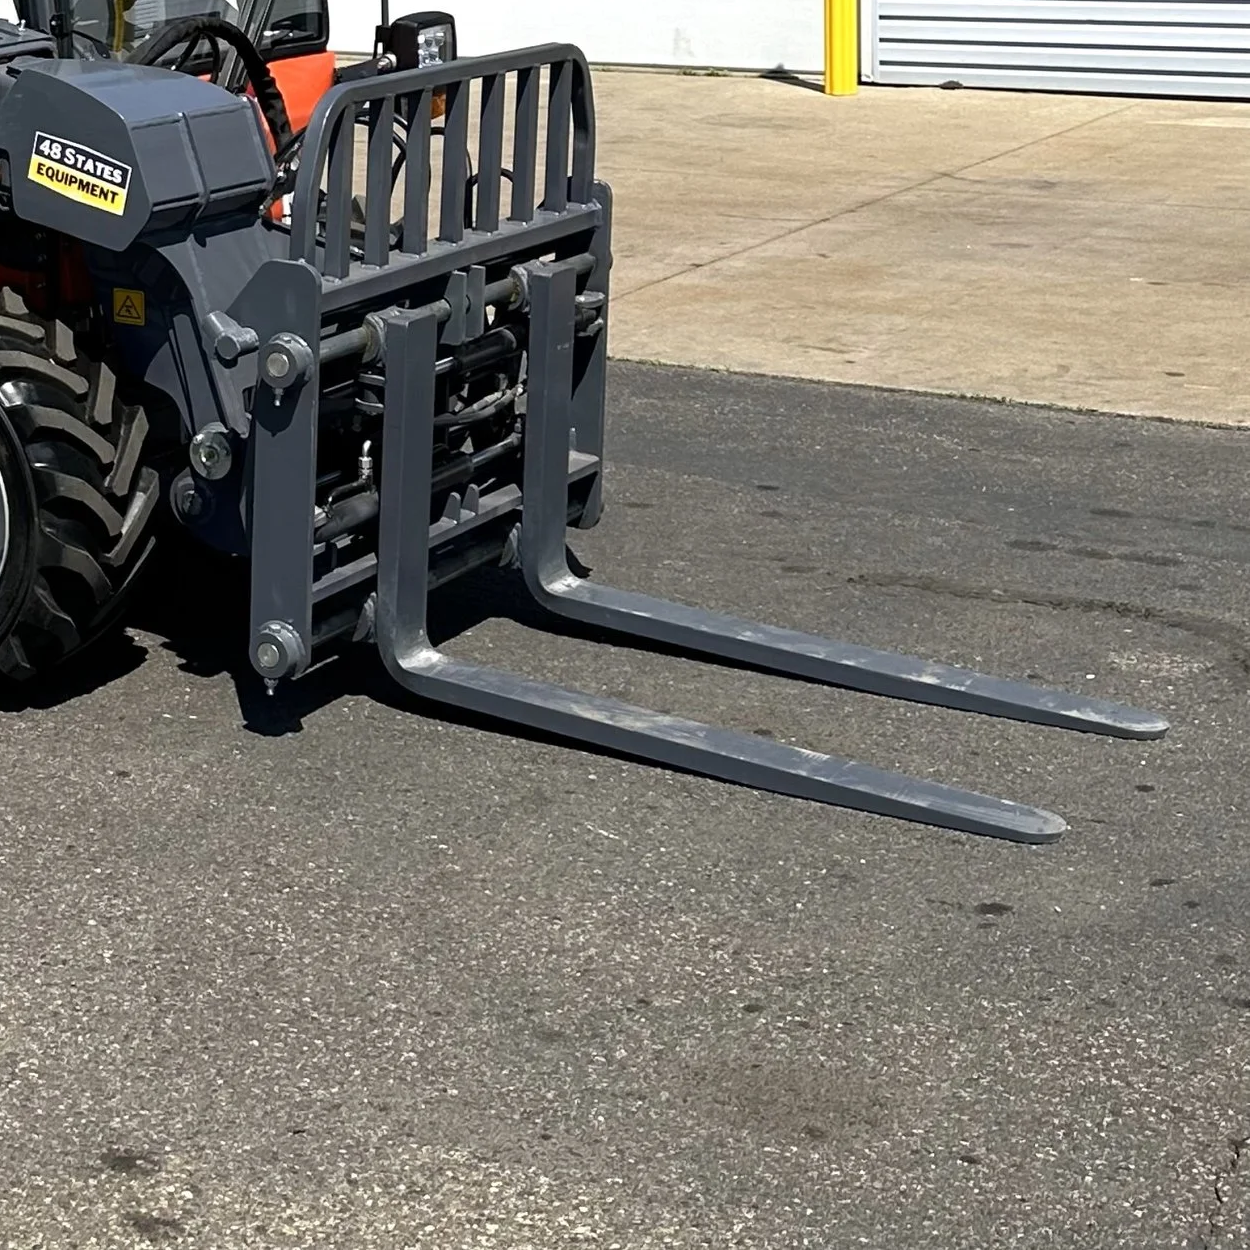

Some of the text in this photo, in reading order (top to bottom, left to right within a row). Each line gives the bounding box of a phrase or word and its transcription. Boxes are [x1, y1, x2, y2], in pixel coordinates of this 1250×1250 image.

[36, 162, 119, 204] EQUIPMENT
[39, 140, 123, 184] 48 STATES
